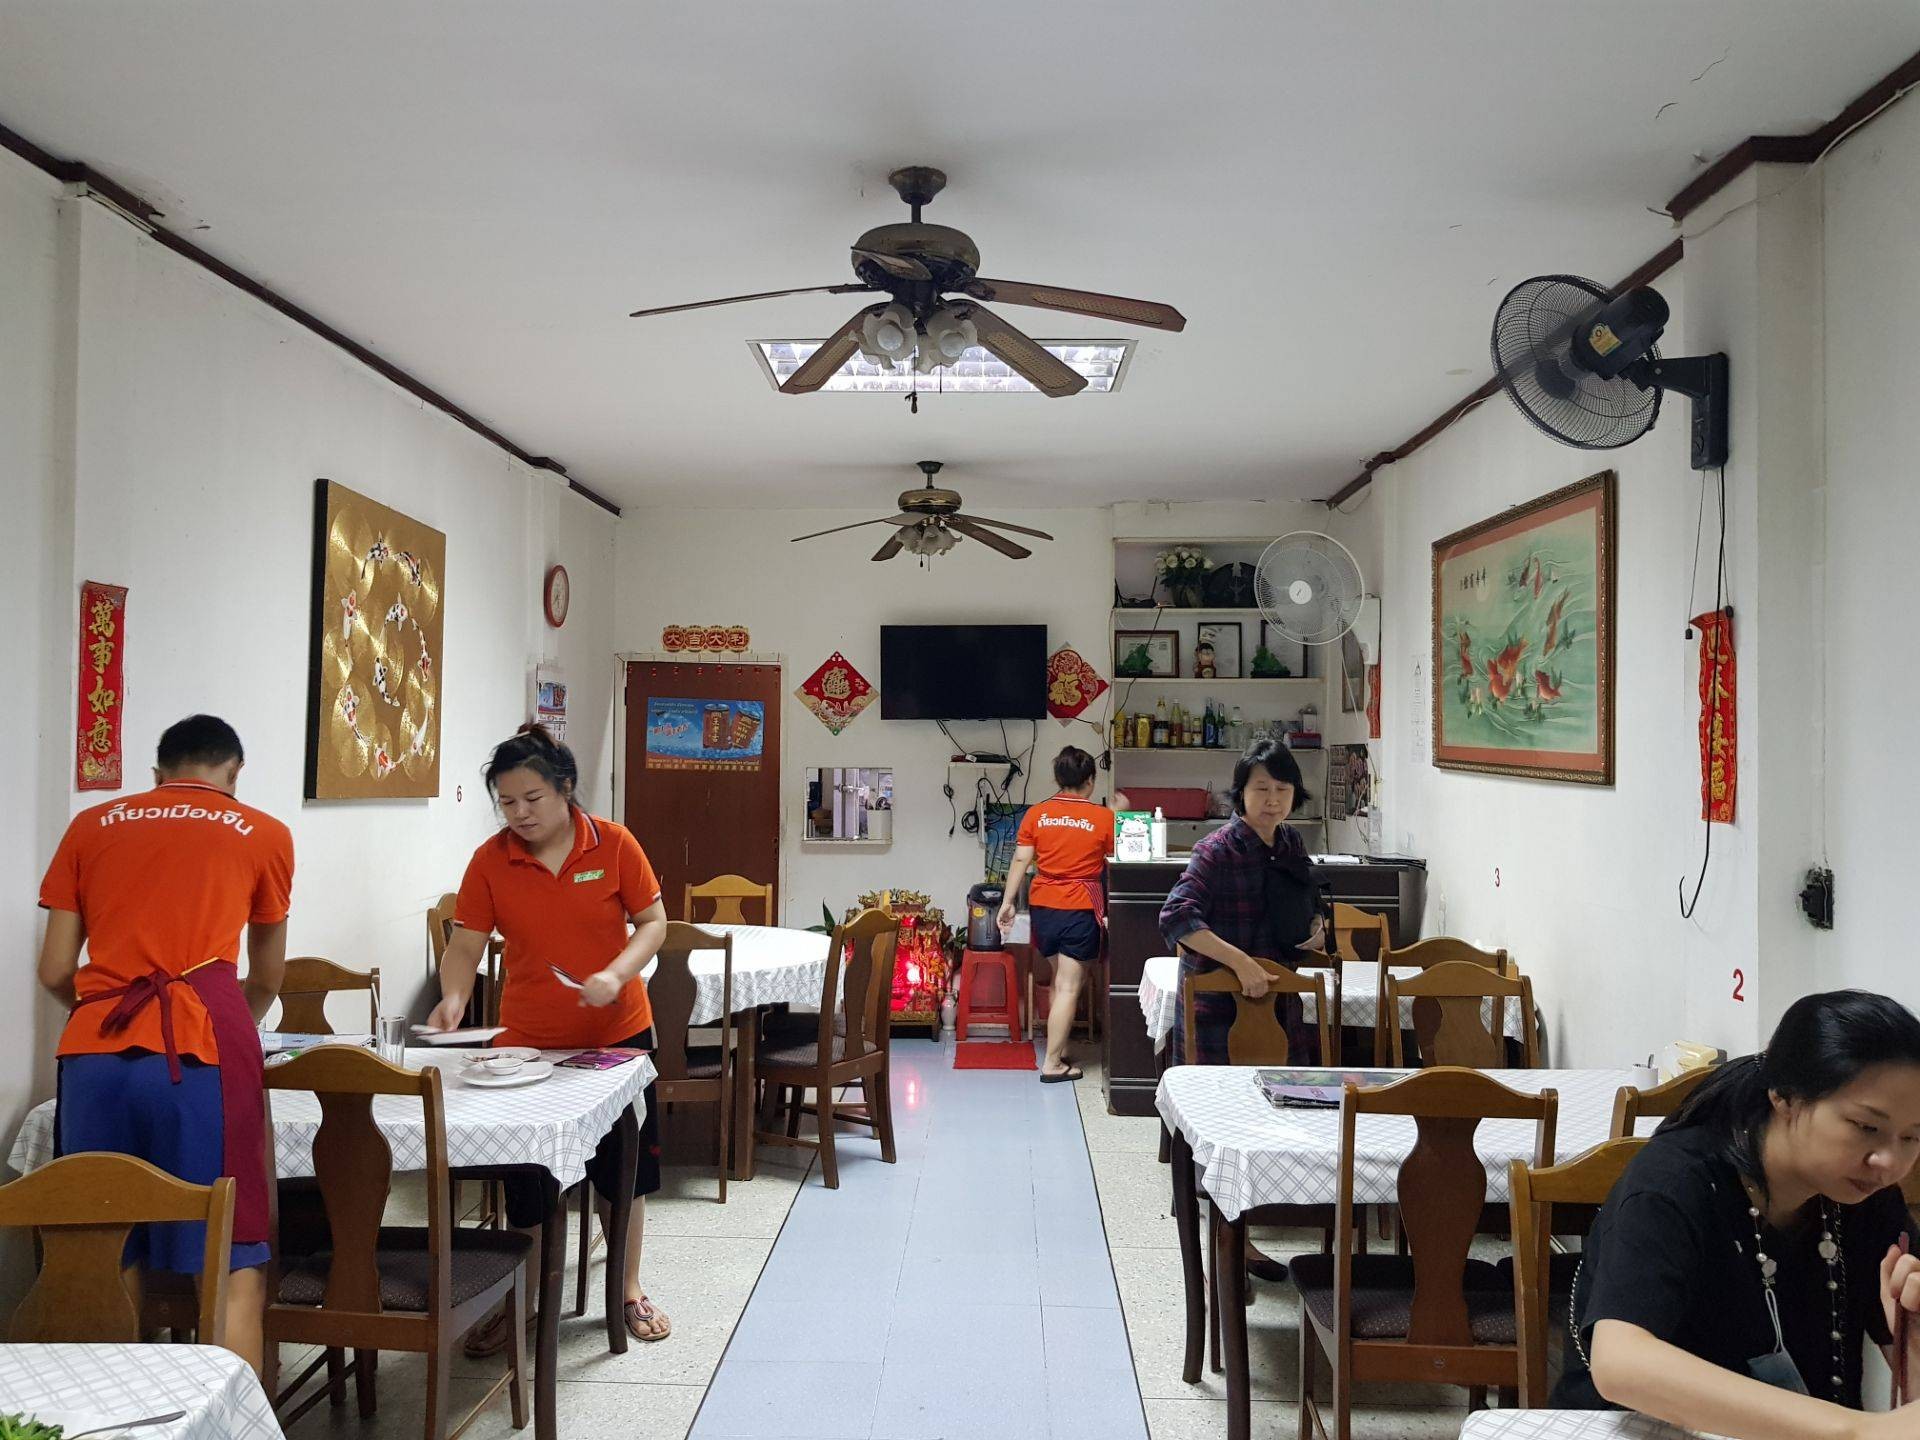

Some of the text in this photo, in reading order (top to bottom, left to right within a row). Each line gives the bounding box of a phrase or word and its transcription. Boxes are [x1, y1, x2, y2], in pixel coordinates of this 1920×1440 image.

[666, 633, 745, 646] 大吉大利
[88, 600, 116, 753] 萬事如意
[456, 785, 462, 802] 6
[1494, 868, 1500, 887] 3
[1732, 969, 1744, 1002] 2
